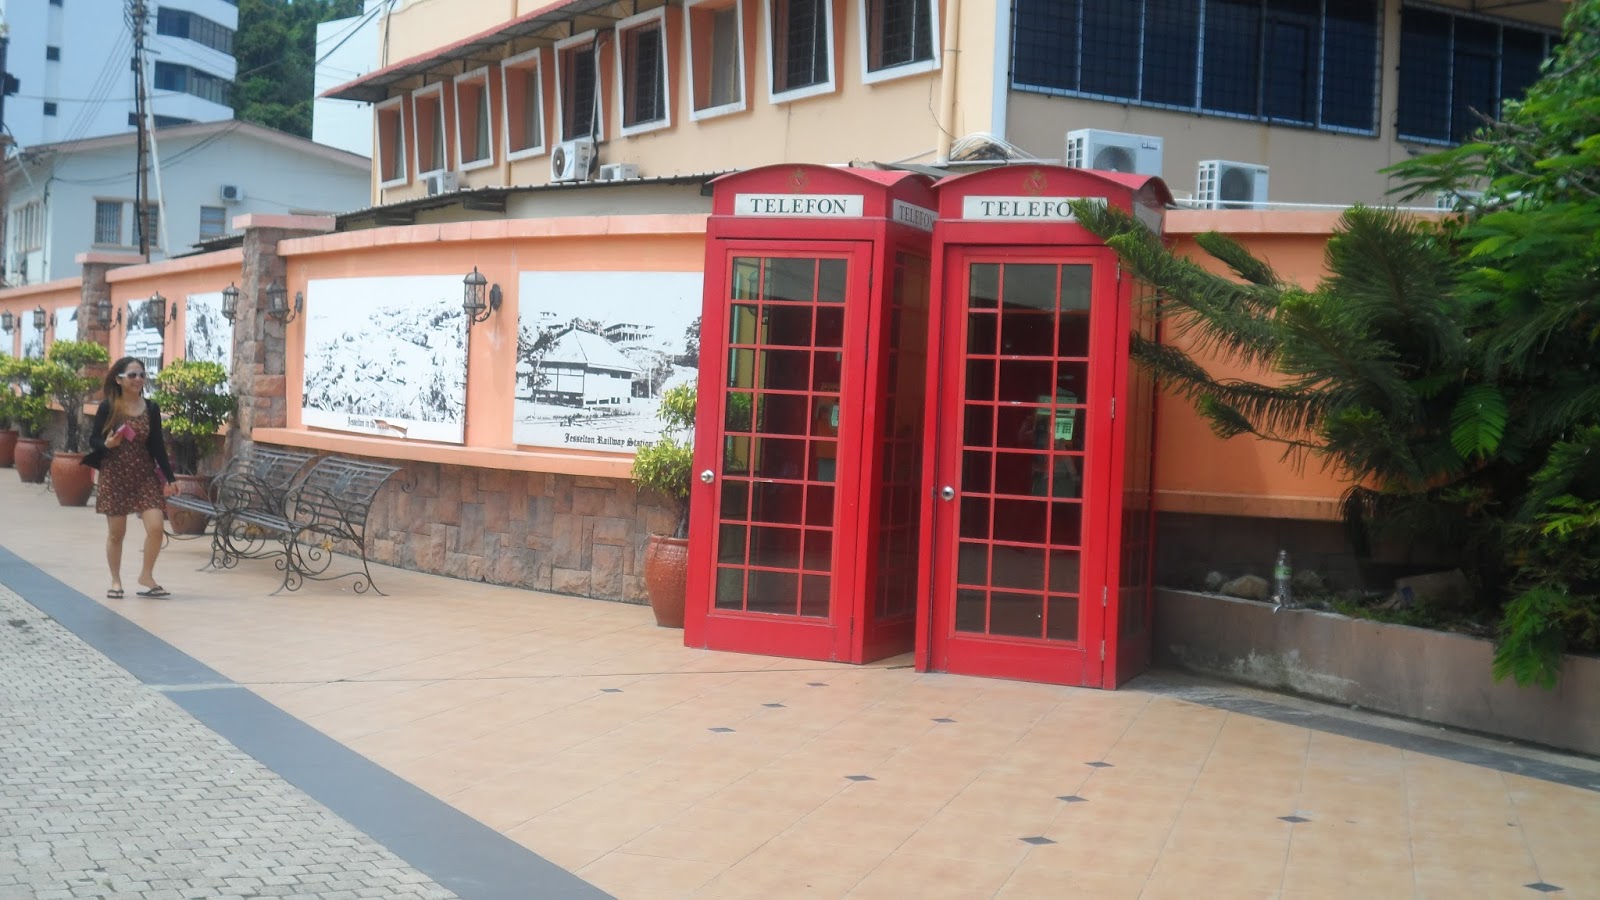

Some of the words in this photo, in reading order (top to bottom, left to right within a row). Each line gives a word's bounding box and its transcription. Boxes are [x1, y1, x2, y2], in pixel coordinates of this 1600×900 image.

[750, 198, 848, 214] TELEFON
[980, 200, 1076, 217] TELEFO
[564, 432, 595, 444] Jesselton
[596, 435, 625, 448] Railway
